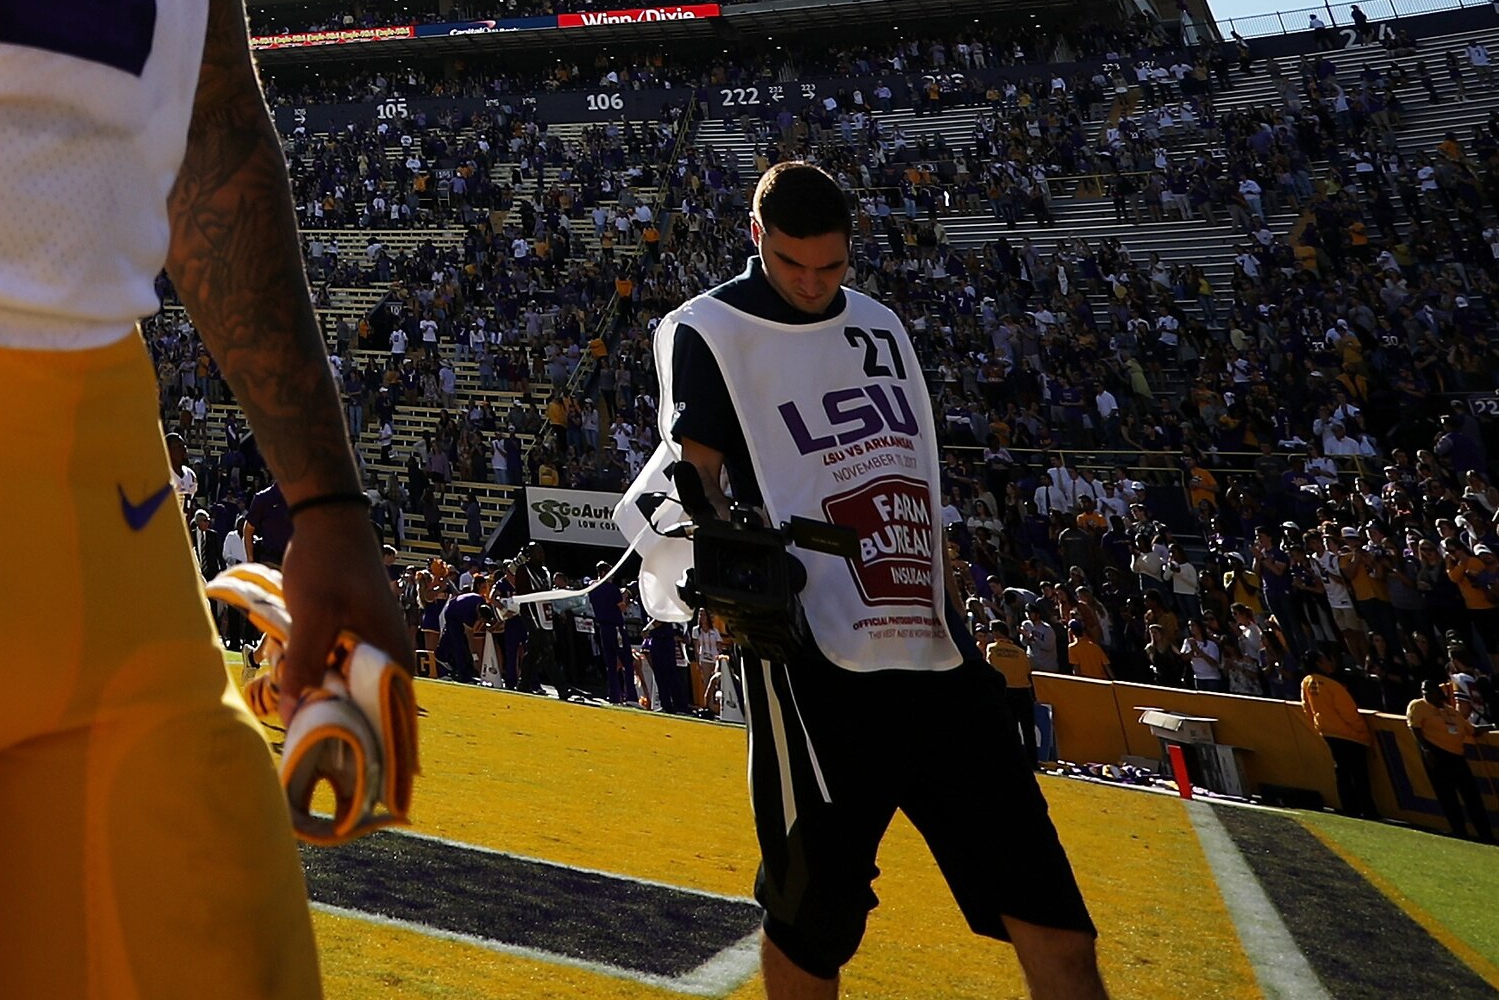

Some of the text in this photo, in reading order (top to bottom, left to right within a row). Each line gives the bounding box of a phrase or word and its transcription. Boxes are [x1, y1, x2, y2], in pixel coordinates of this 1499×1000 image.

[719, 86, 761, 107] 222
[768, 85, 784, 93] 222
[800, 83, 817, 92] 223
[376, 103, 408, 119] 105
[586, 92, 624, 111] 106
[1381, 334, 1399, 347] 30
[842, 325, 908, 380] 27
[777, 384, 919, 456] LSU
[823, 450, 846, 466] LSU
[844, 444, 864, 457] VS
[832, 453, 897, 482] NOVEMBER
[871, 492, 931, 526] FARM
[578, 520, 596, 529] LOW
[890, 565, 932, 587] INSURAN
[852, 616, 888, 631] OFFICIAL
